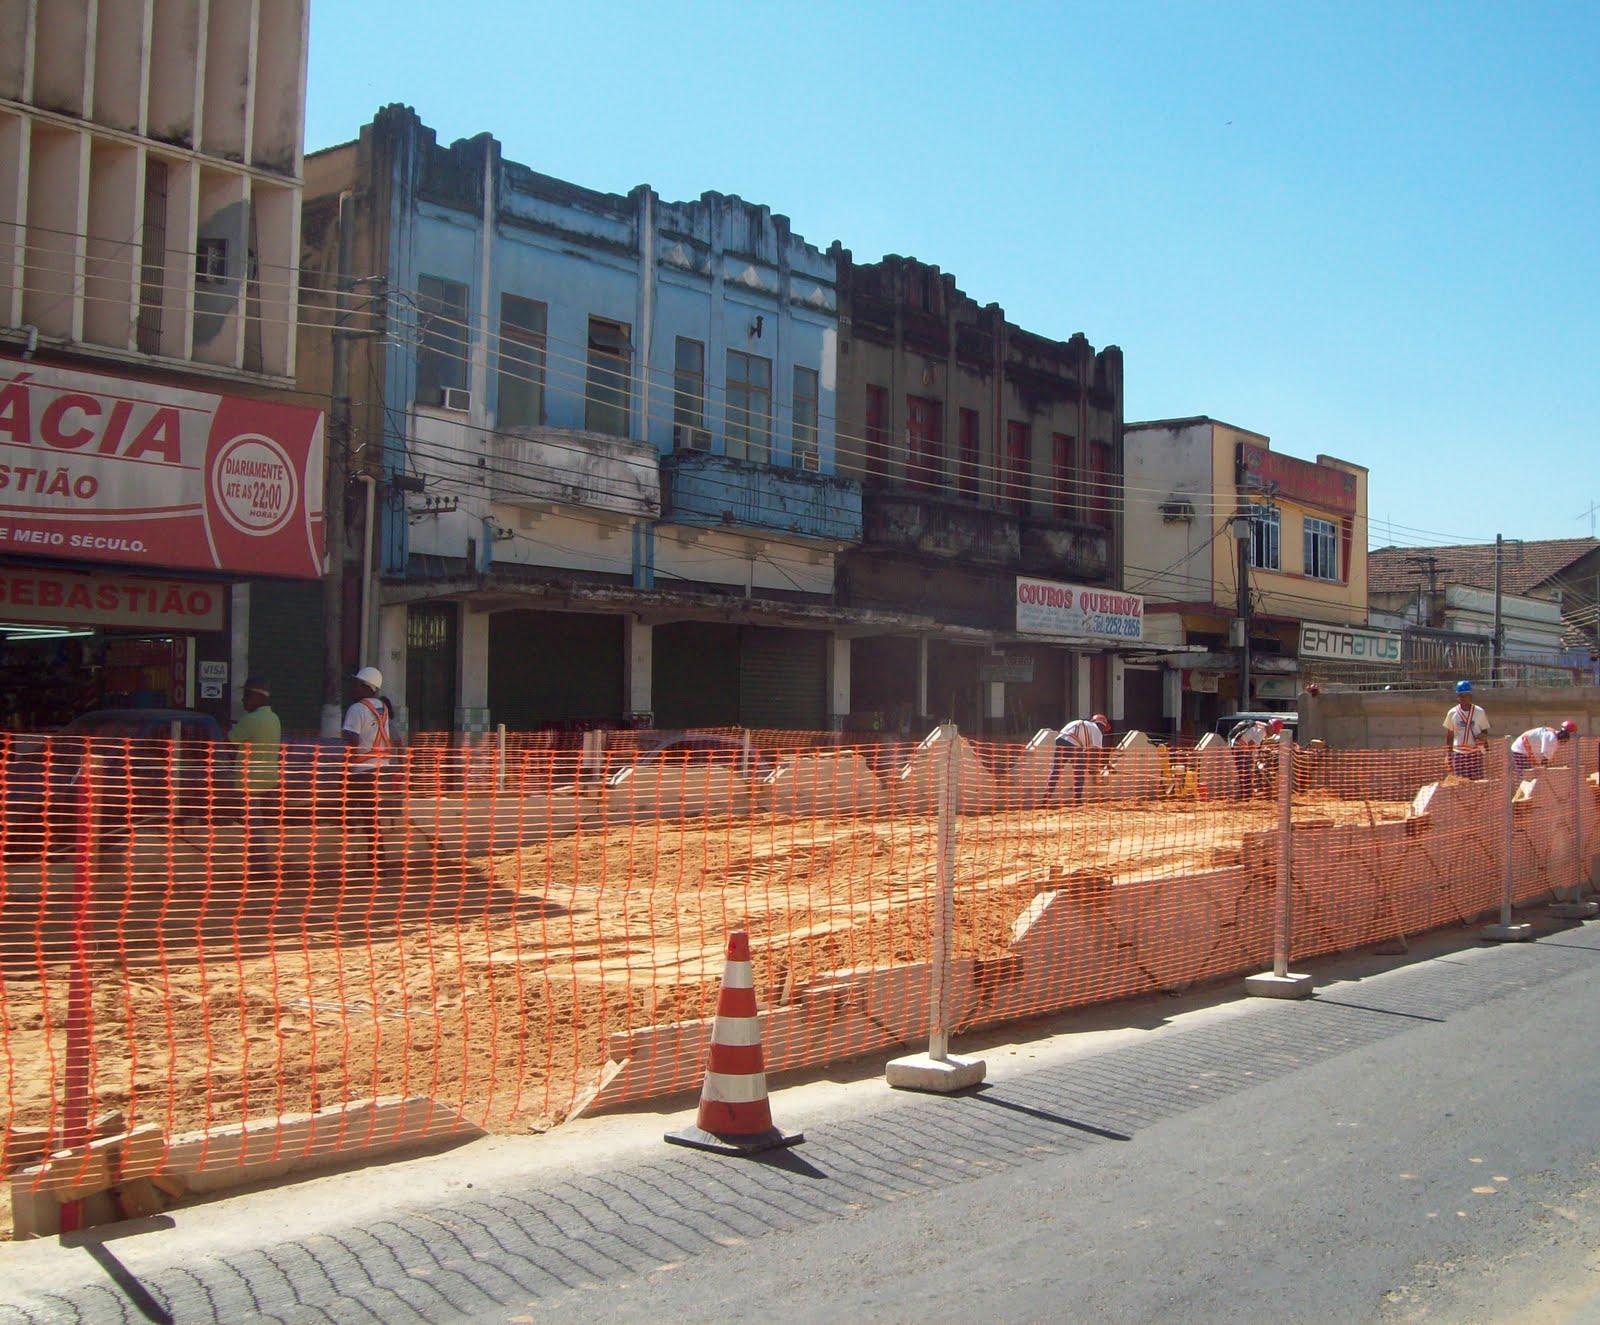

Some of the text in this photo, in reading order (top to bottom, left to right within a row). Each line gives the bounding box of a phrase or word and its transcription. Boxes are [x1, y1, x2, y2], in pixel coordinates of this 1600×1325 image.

[225, 458, 284, 481] DIARIAMENTE
[252, 481, 282, 511] 22:00
[249, 510, 279, 519] HORAS
[13, 528, 64, 546] MEIO
[0, 576, 213, 616] EBASTIÃO
[1019, 583, 1073, 609] COUROS
[203, 664, 226, 676] VISA
